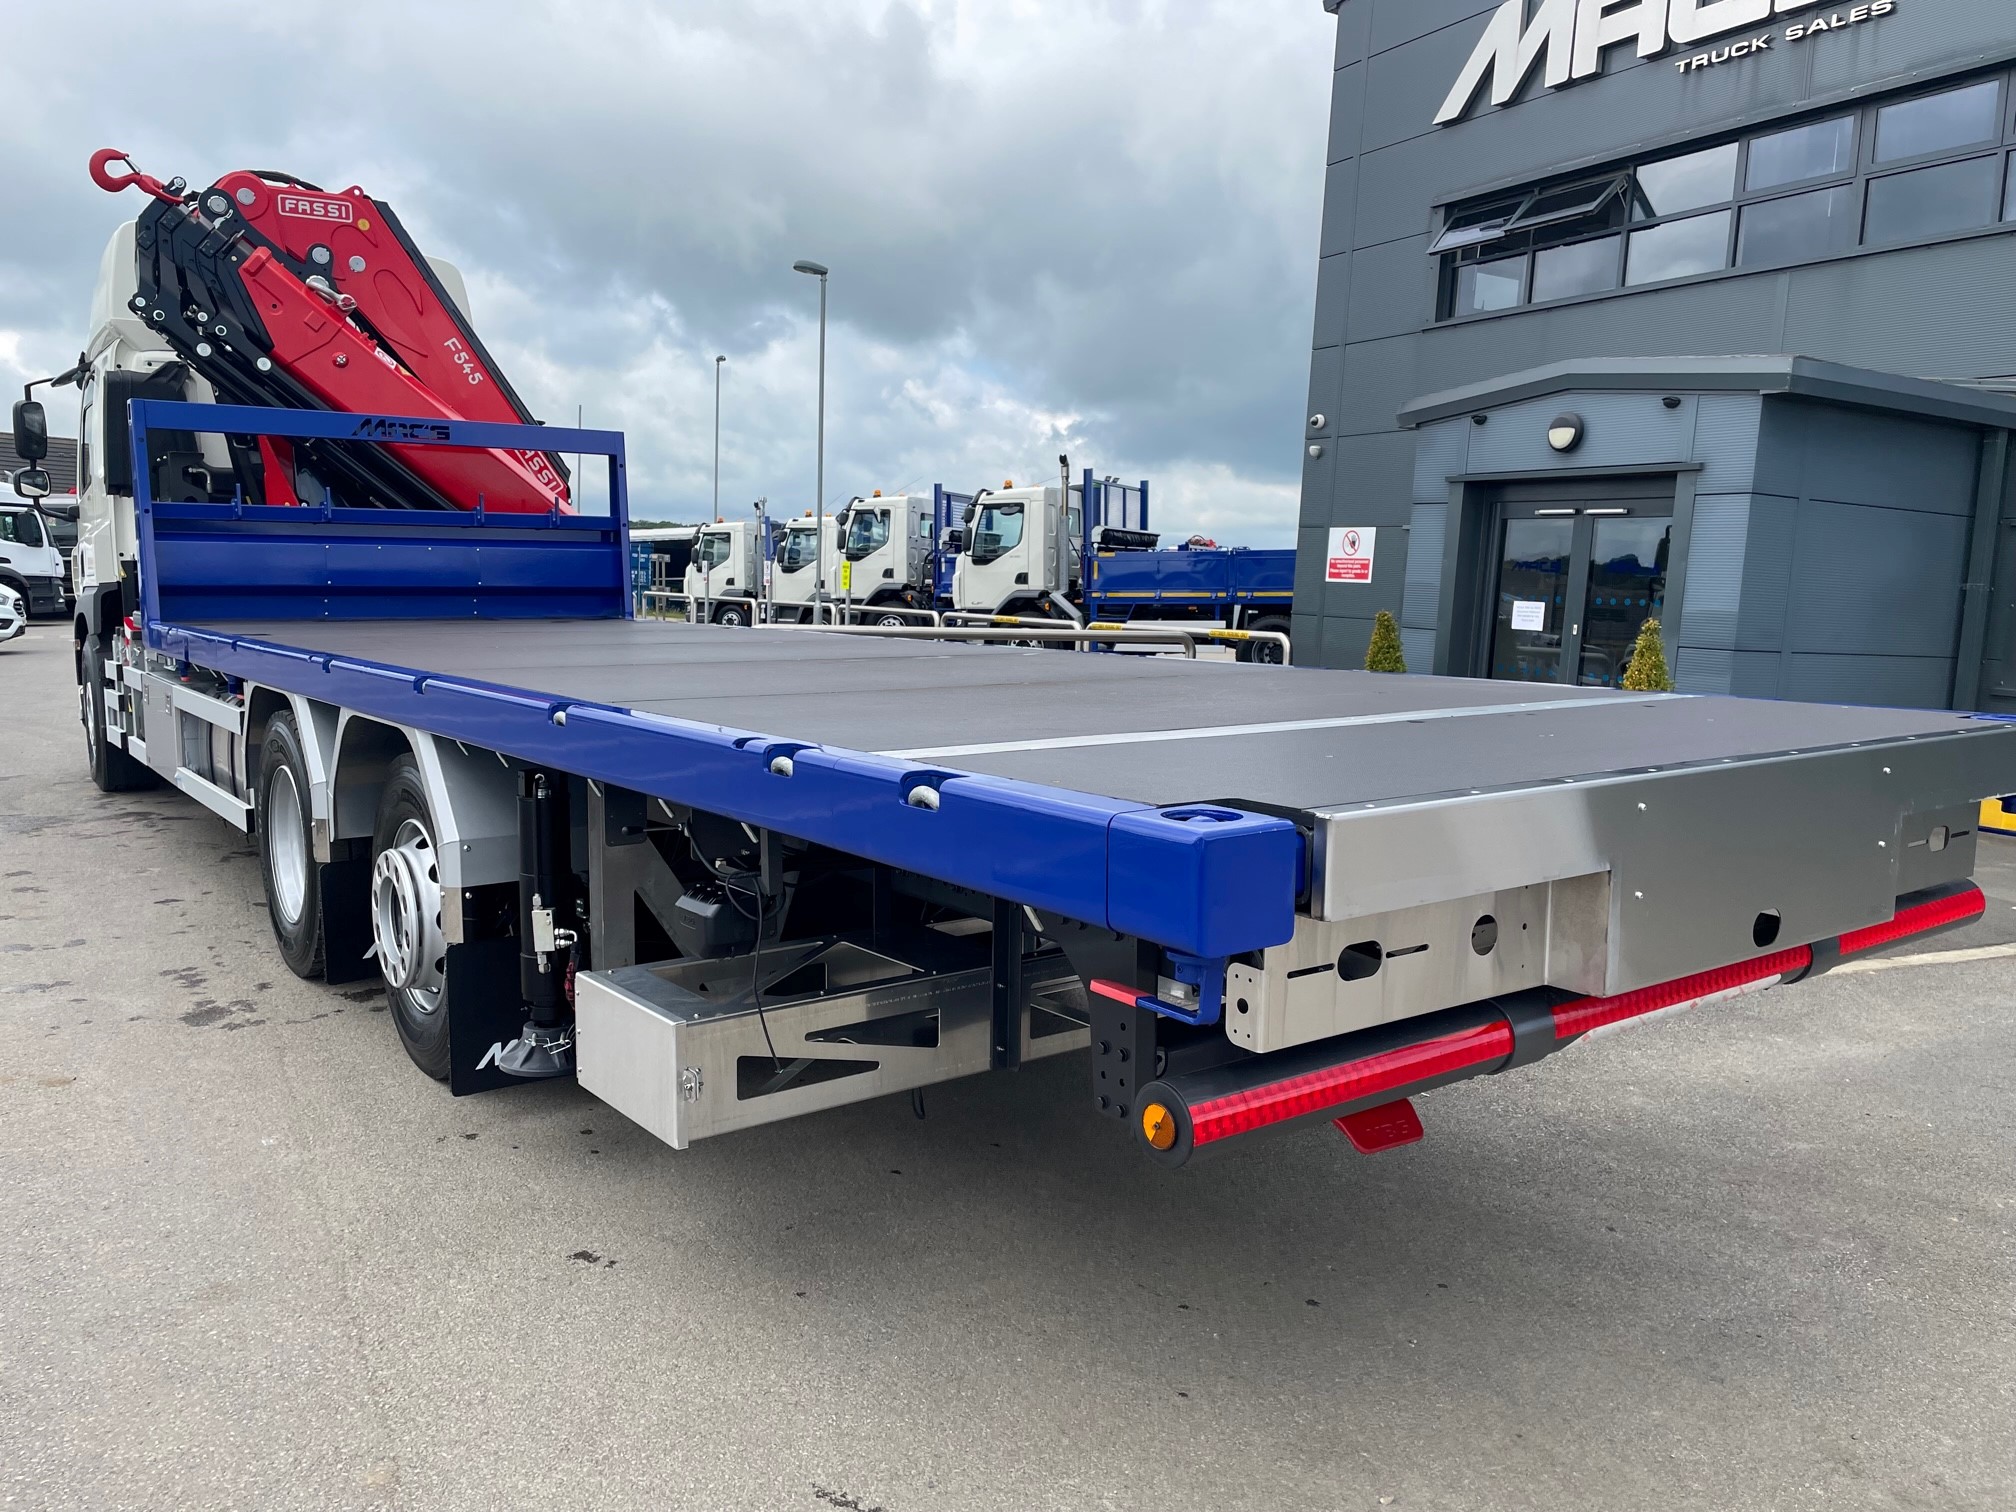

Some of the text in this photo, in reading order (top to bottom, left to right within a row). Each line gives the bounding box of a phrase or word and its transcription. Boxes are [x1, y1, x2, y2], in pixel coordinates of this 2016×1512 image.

[1674, 0, 1893, 73] TRUCK SALES
[285, 199, 346, 218] FASSI
[443, 337, 484, 385] F545
[520, 449, 557, 489] ASSI
